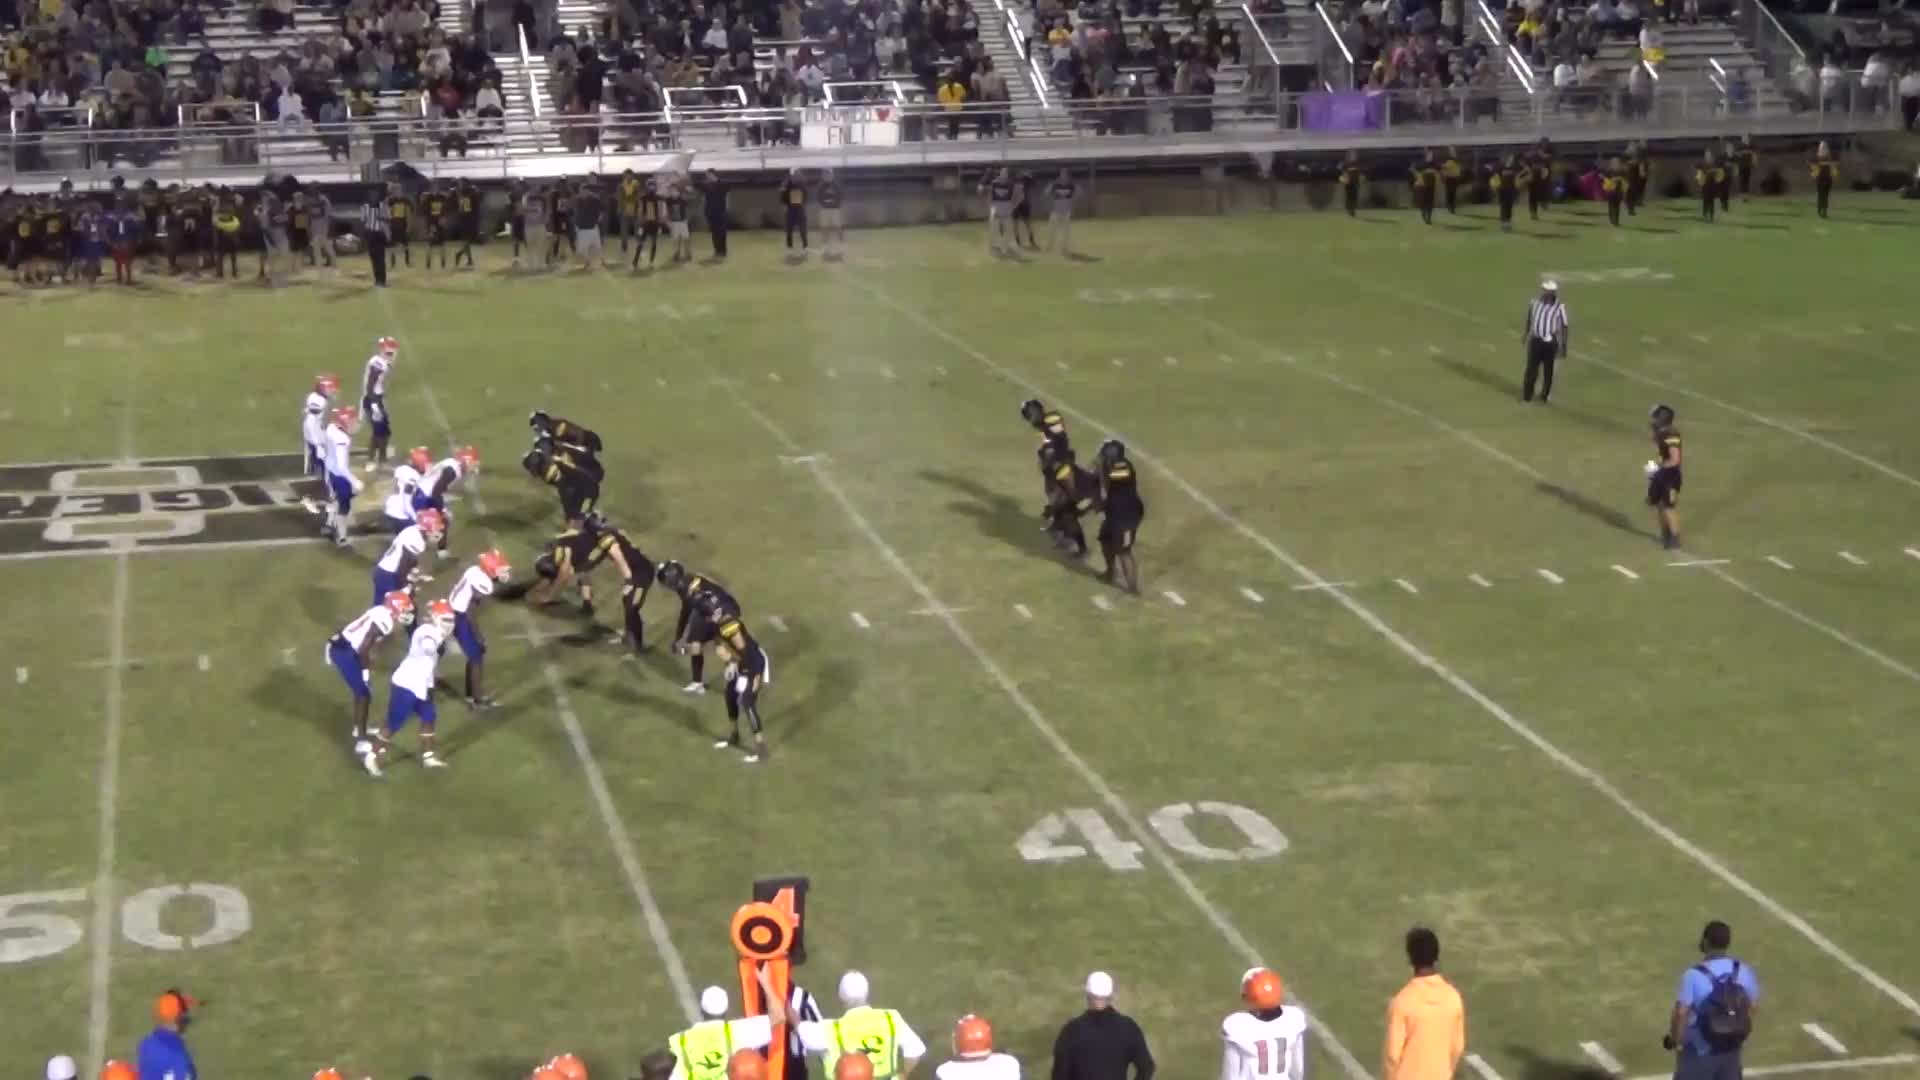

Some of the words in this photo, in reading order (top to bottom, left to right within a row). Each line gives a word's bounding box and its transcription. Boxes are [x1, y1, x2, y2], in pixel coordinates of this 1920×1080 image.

[1014, 800, 1290, 870] 40
[0, 883, 252, 964] 50
[1254, 1037, 1288, 1075] 11
